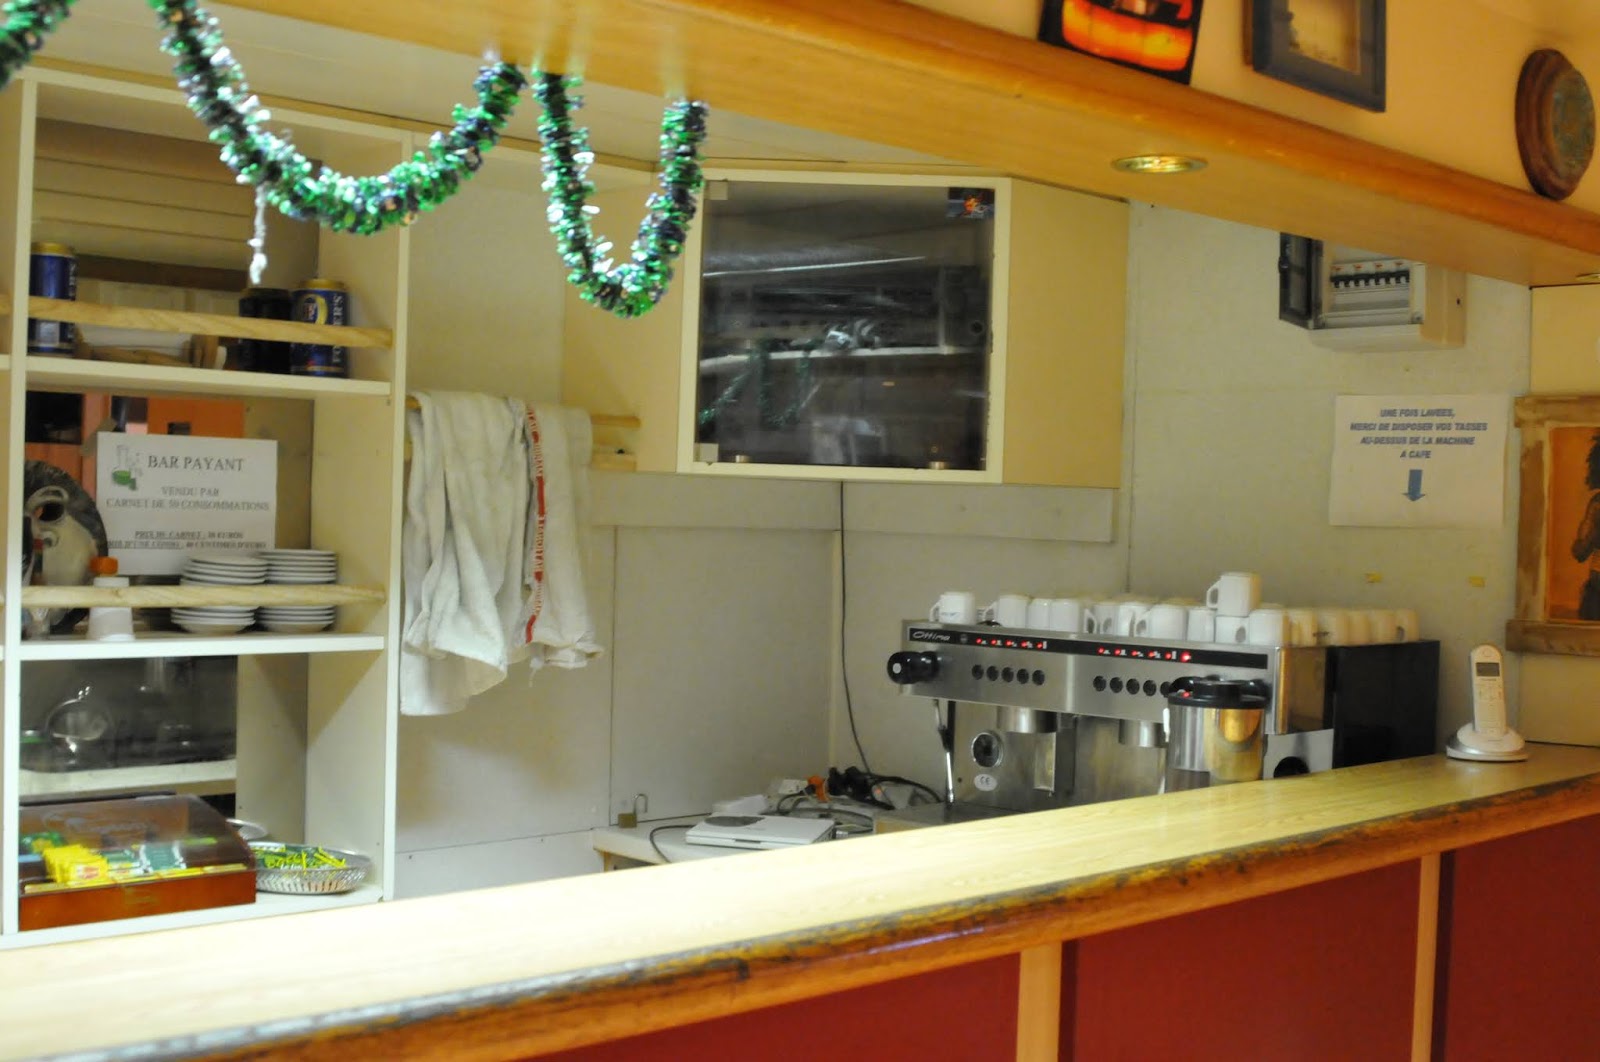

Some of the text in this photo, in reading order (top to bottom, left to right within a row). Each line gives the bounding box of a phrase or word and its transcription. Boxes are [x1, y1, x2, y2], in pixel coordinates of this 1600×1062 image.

[1380, 408, 1398, 418] UNE
[1399, 408, 1419, 418] FOIS
[1350, 422, 1488, 431] MERCI DE DISPOSER VOS TASSES
[1360, 436, 1476, 446] AU-DESSUS DE LA MACHINE
[147, 455, 245, 472] BAR PAYANT
[160, 486, 220, 497] VENDU PAR
[105, 498, 150, 509] CARNET
[151, 499, 165, 510] DE
[181, 499, 270, 512] CONSOMMATIONS
